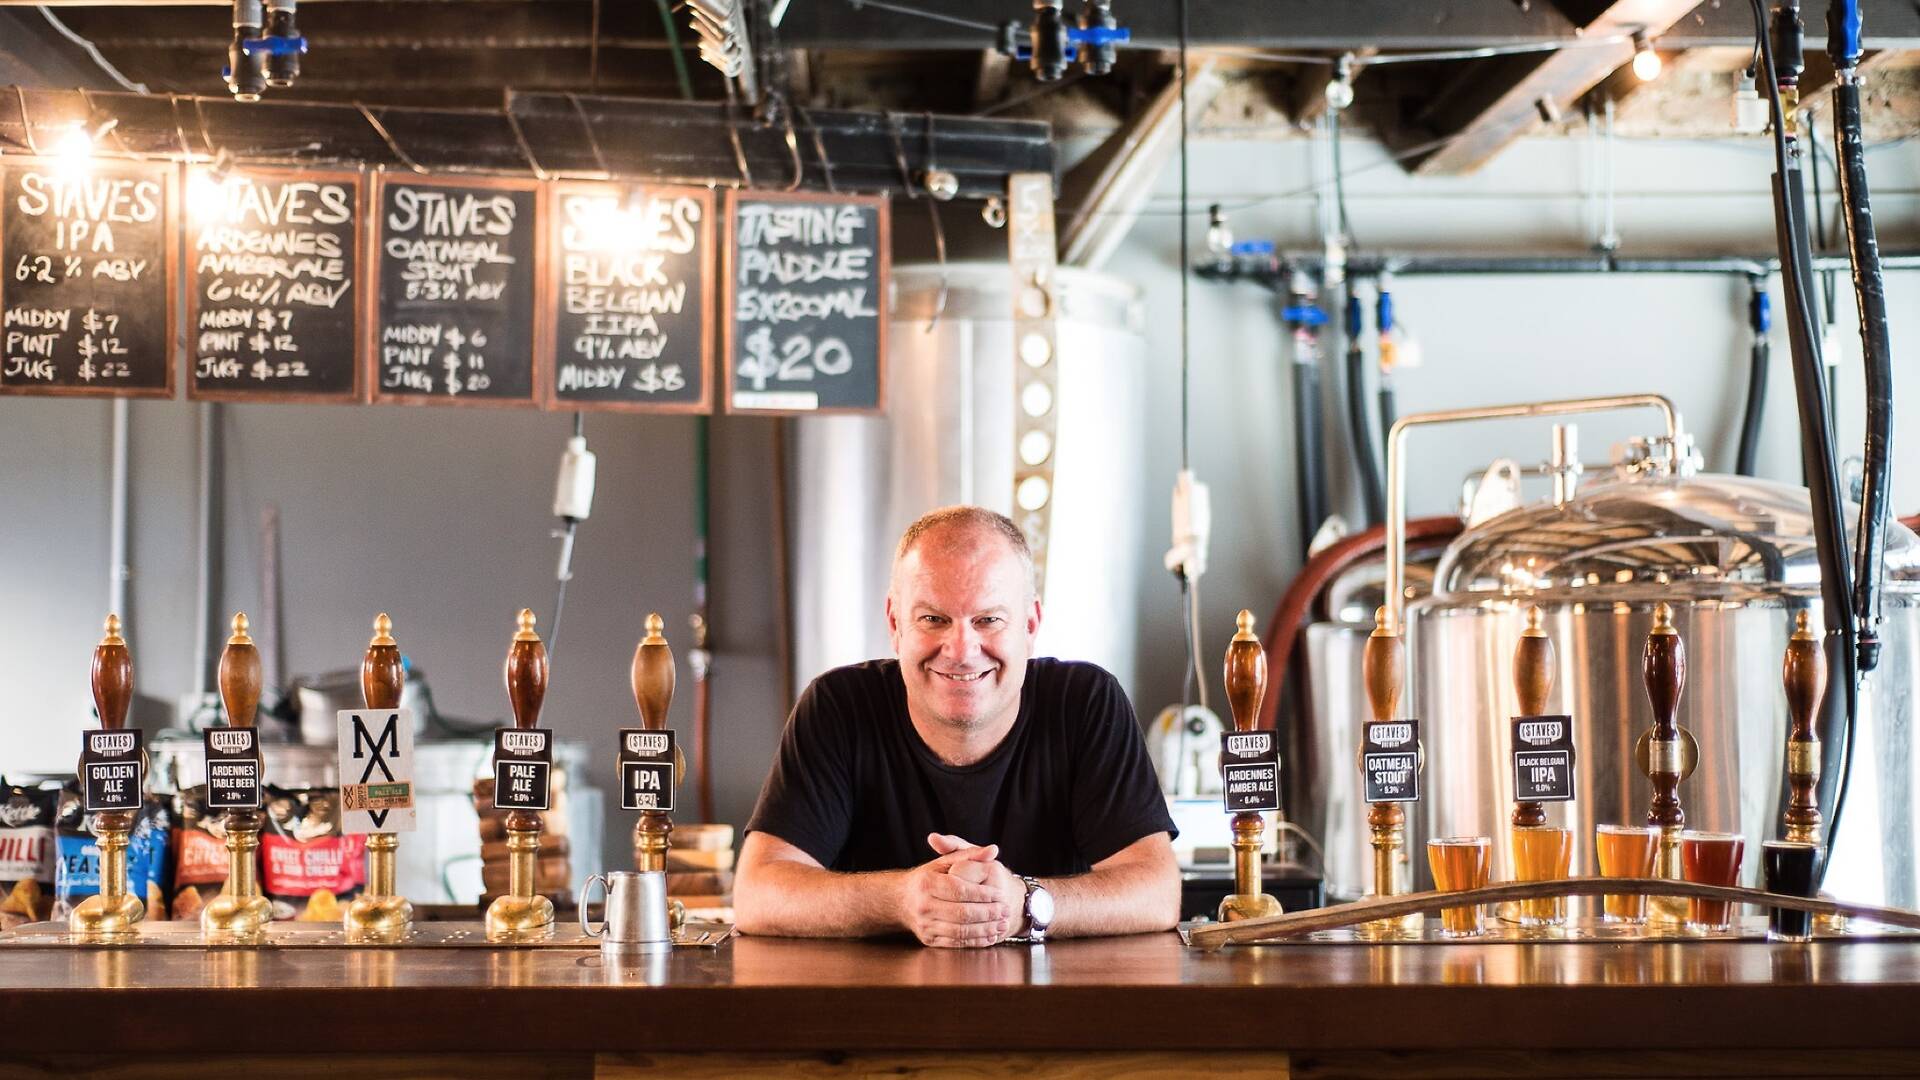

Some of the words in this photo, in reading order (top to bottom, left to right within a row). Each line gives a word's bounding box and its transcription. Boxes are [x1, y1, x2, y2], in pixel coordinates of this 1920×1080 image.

[17, 172, 160, 223] STAVES
[199, 176, 350, 225] TAVES
[388, 187, 517, 236] STAVES
[56, 219, 114, 252] IPA
[562, 196, 701, 254] SES
[738, 204, 866, 246] TASTING
[197, 225, 342, 258] ARDENNES
[386, 238, 516, 264] OATMEAL
[92, 259, 146, 280] ABV
[565, 254, 668, 287] BLACK
[739, 247, 873, 286] PADDLE
[286, 279, 351, 308] ABV
[566, 280, 686, 314] BELGIAN
[4, 307, 70, 331] MIDDY
[200, 309, 253, 329] MIDDY
[7, 332, 59, 357] PINT
[200, 332, 244, 352] PINT
[383, 324, 442, 345] MIDDY
[384, 347, 433, 366] PINT
[619, 334, 668, 359] ABV
[4, 356, 57, 380] JUG
[196, 357, 244, 379] JUG
[737, 326, 853, 390] $20
[558, 364, 626, 391] MIDDY
[632, 363, 686, 393] $8
[93, 766, 134, 779] GOLDEN
[212, 766, 254, 776] ARDENNES
[510, 765, 535, 778] PALE
[1369, 757, 1413, 771] OATMEAL
[1520, 758, 1539, 766] BLACK
[1540, 757, 1565, 766] BELGIAN
[212, 779, 234, 788] TABLE
[236, 779, 255, 788] BEER
[512, 779, 531, 791] ALE
[635, 770, 660, 790] IPA
[1229, 769, 1273, 781] ARDENNES
[1375, 771, 1407, 784] STOUT
[1531, 767, 1556, 782] IIPA
[104, 780, 123, 792] ALE
[1230, 782, 1257, 793] AMBER
[1259, 781, 1273, 791] ALE
